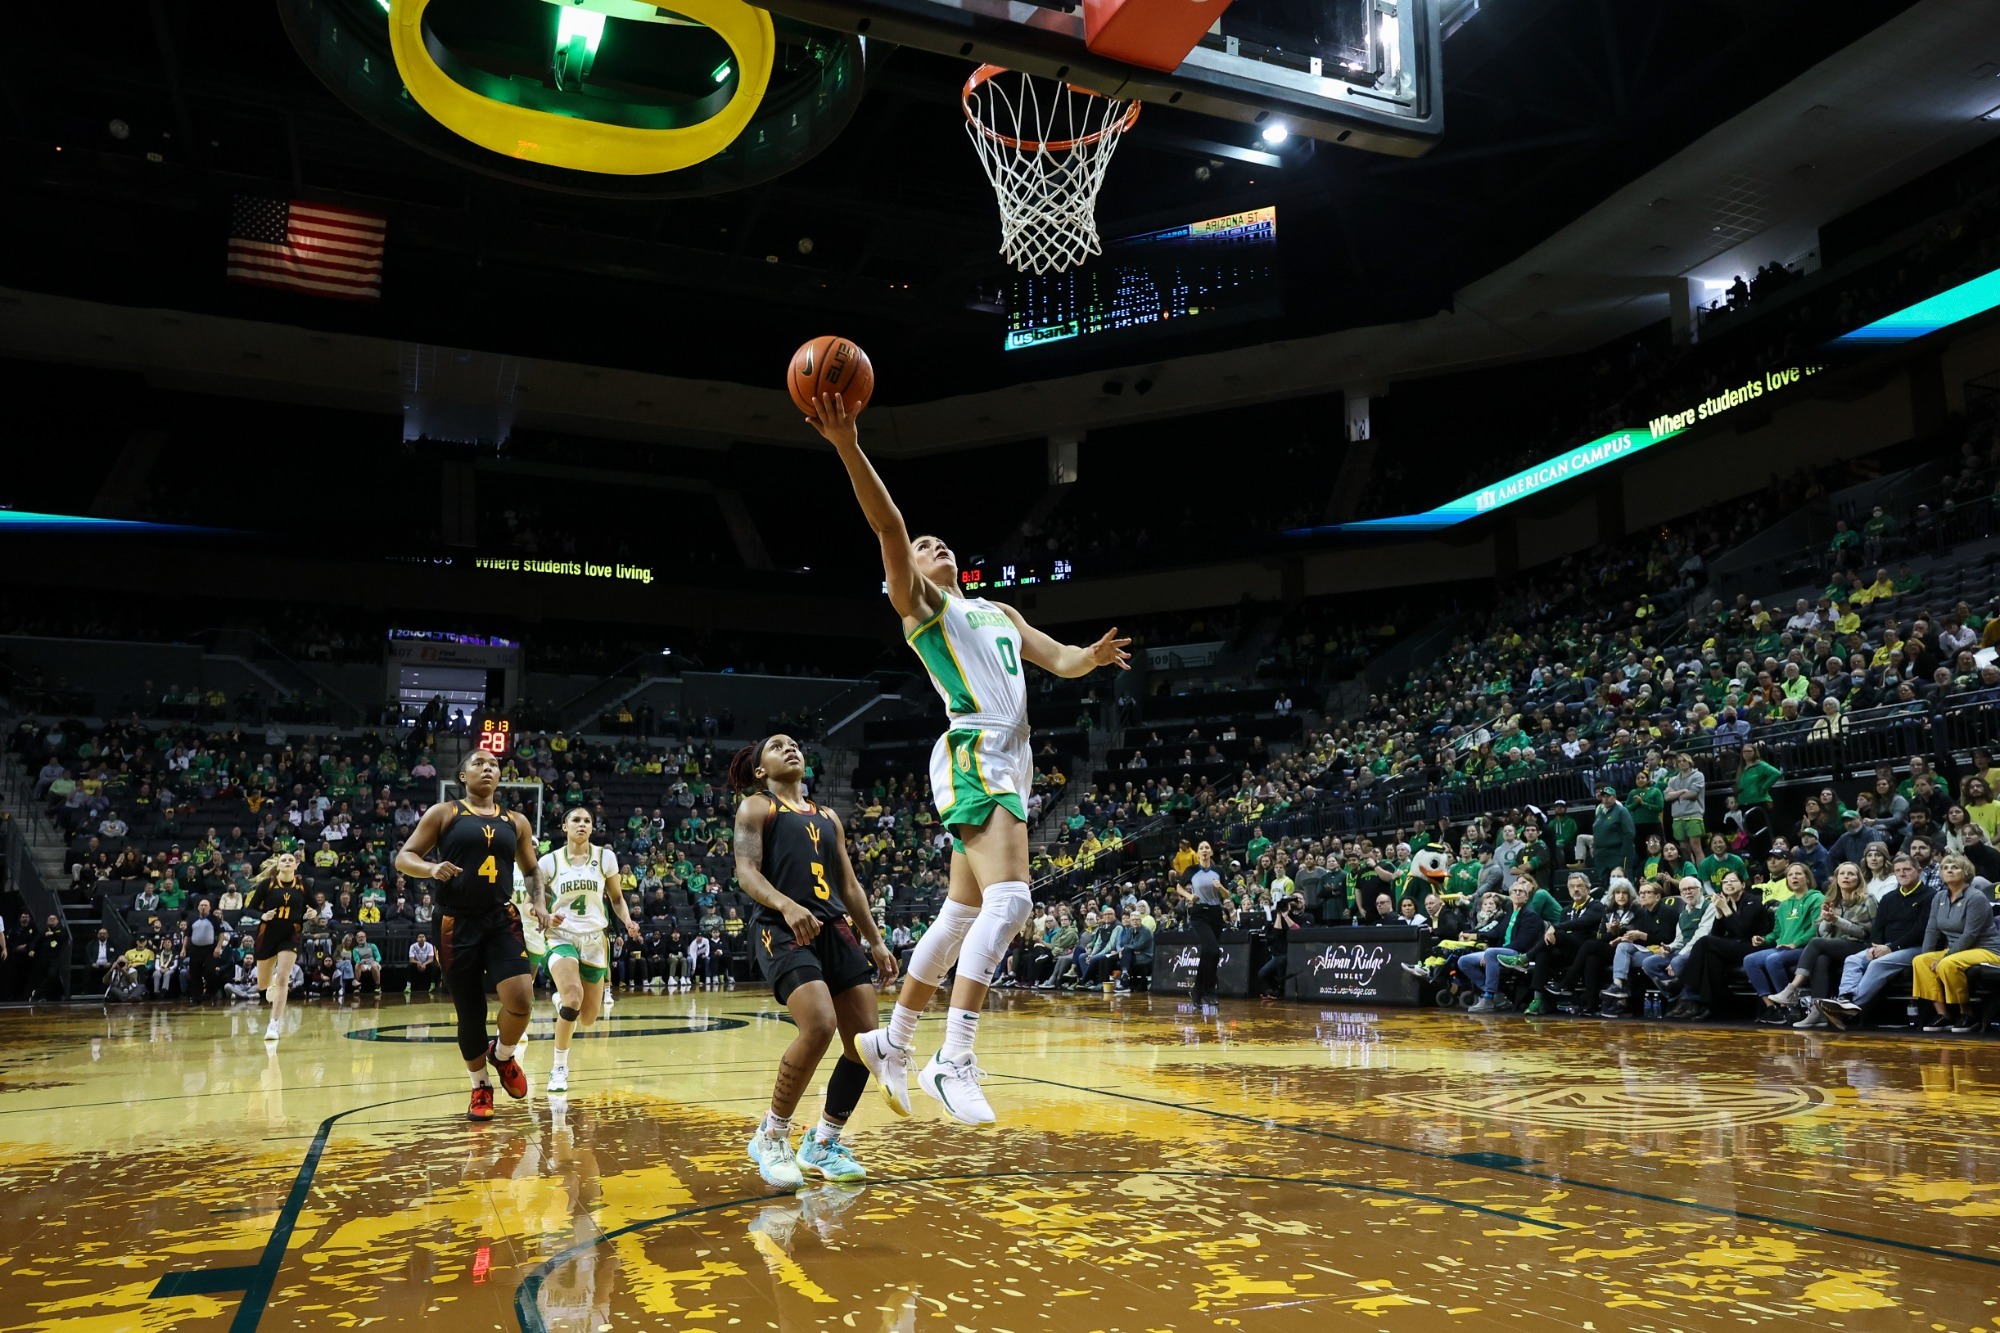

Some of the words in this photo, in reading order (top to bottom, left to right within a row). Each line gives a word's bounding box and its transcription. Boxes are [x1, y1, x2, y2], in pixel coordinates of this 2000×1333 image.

[1205, 215, 1244, 232] ARIZONA
[1247, 212, 1258, 223] ST
[826, 342, 850, 384] ELITE
[1648, 408, 1696, 440] Where
[1698, 379, 1764, 420] students
[1766, 366, 1801, 392] love
[1498, 459, 1568, 501] AMERICAN
[1570, 433, 1632, 470] CAMPUS
[523, 559, 581, 576] students
[585, 563, 612, 578] love
[616, 564, 654, 584] living.
[962, 570, 980, 583] 8:13
[1002, 565, 1015, 579] 14
[966, 582, 979, 591] 2ND
[995, 636, 1018, 676] 0
[1151, 655, 1169, 666] 109
[484, 719, 509, 733] 8:13
[480, 732, 505, 753] 28
[478, 855, 498, 884] 4
[560, 879, 599, 895] OREGON
[810, 862, 830, 900] 3
[278, 906, 290, 919] 11
[569, 894, 587, 916] 4
[1350, 944, 1384, 987] Ridge
[1334, 972, 1364, 981] WINERY
